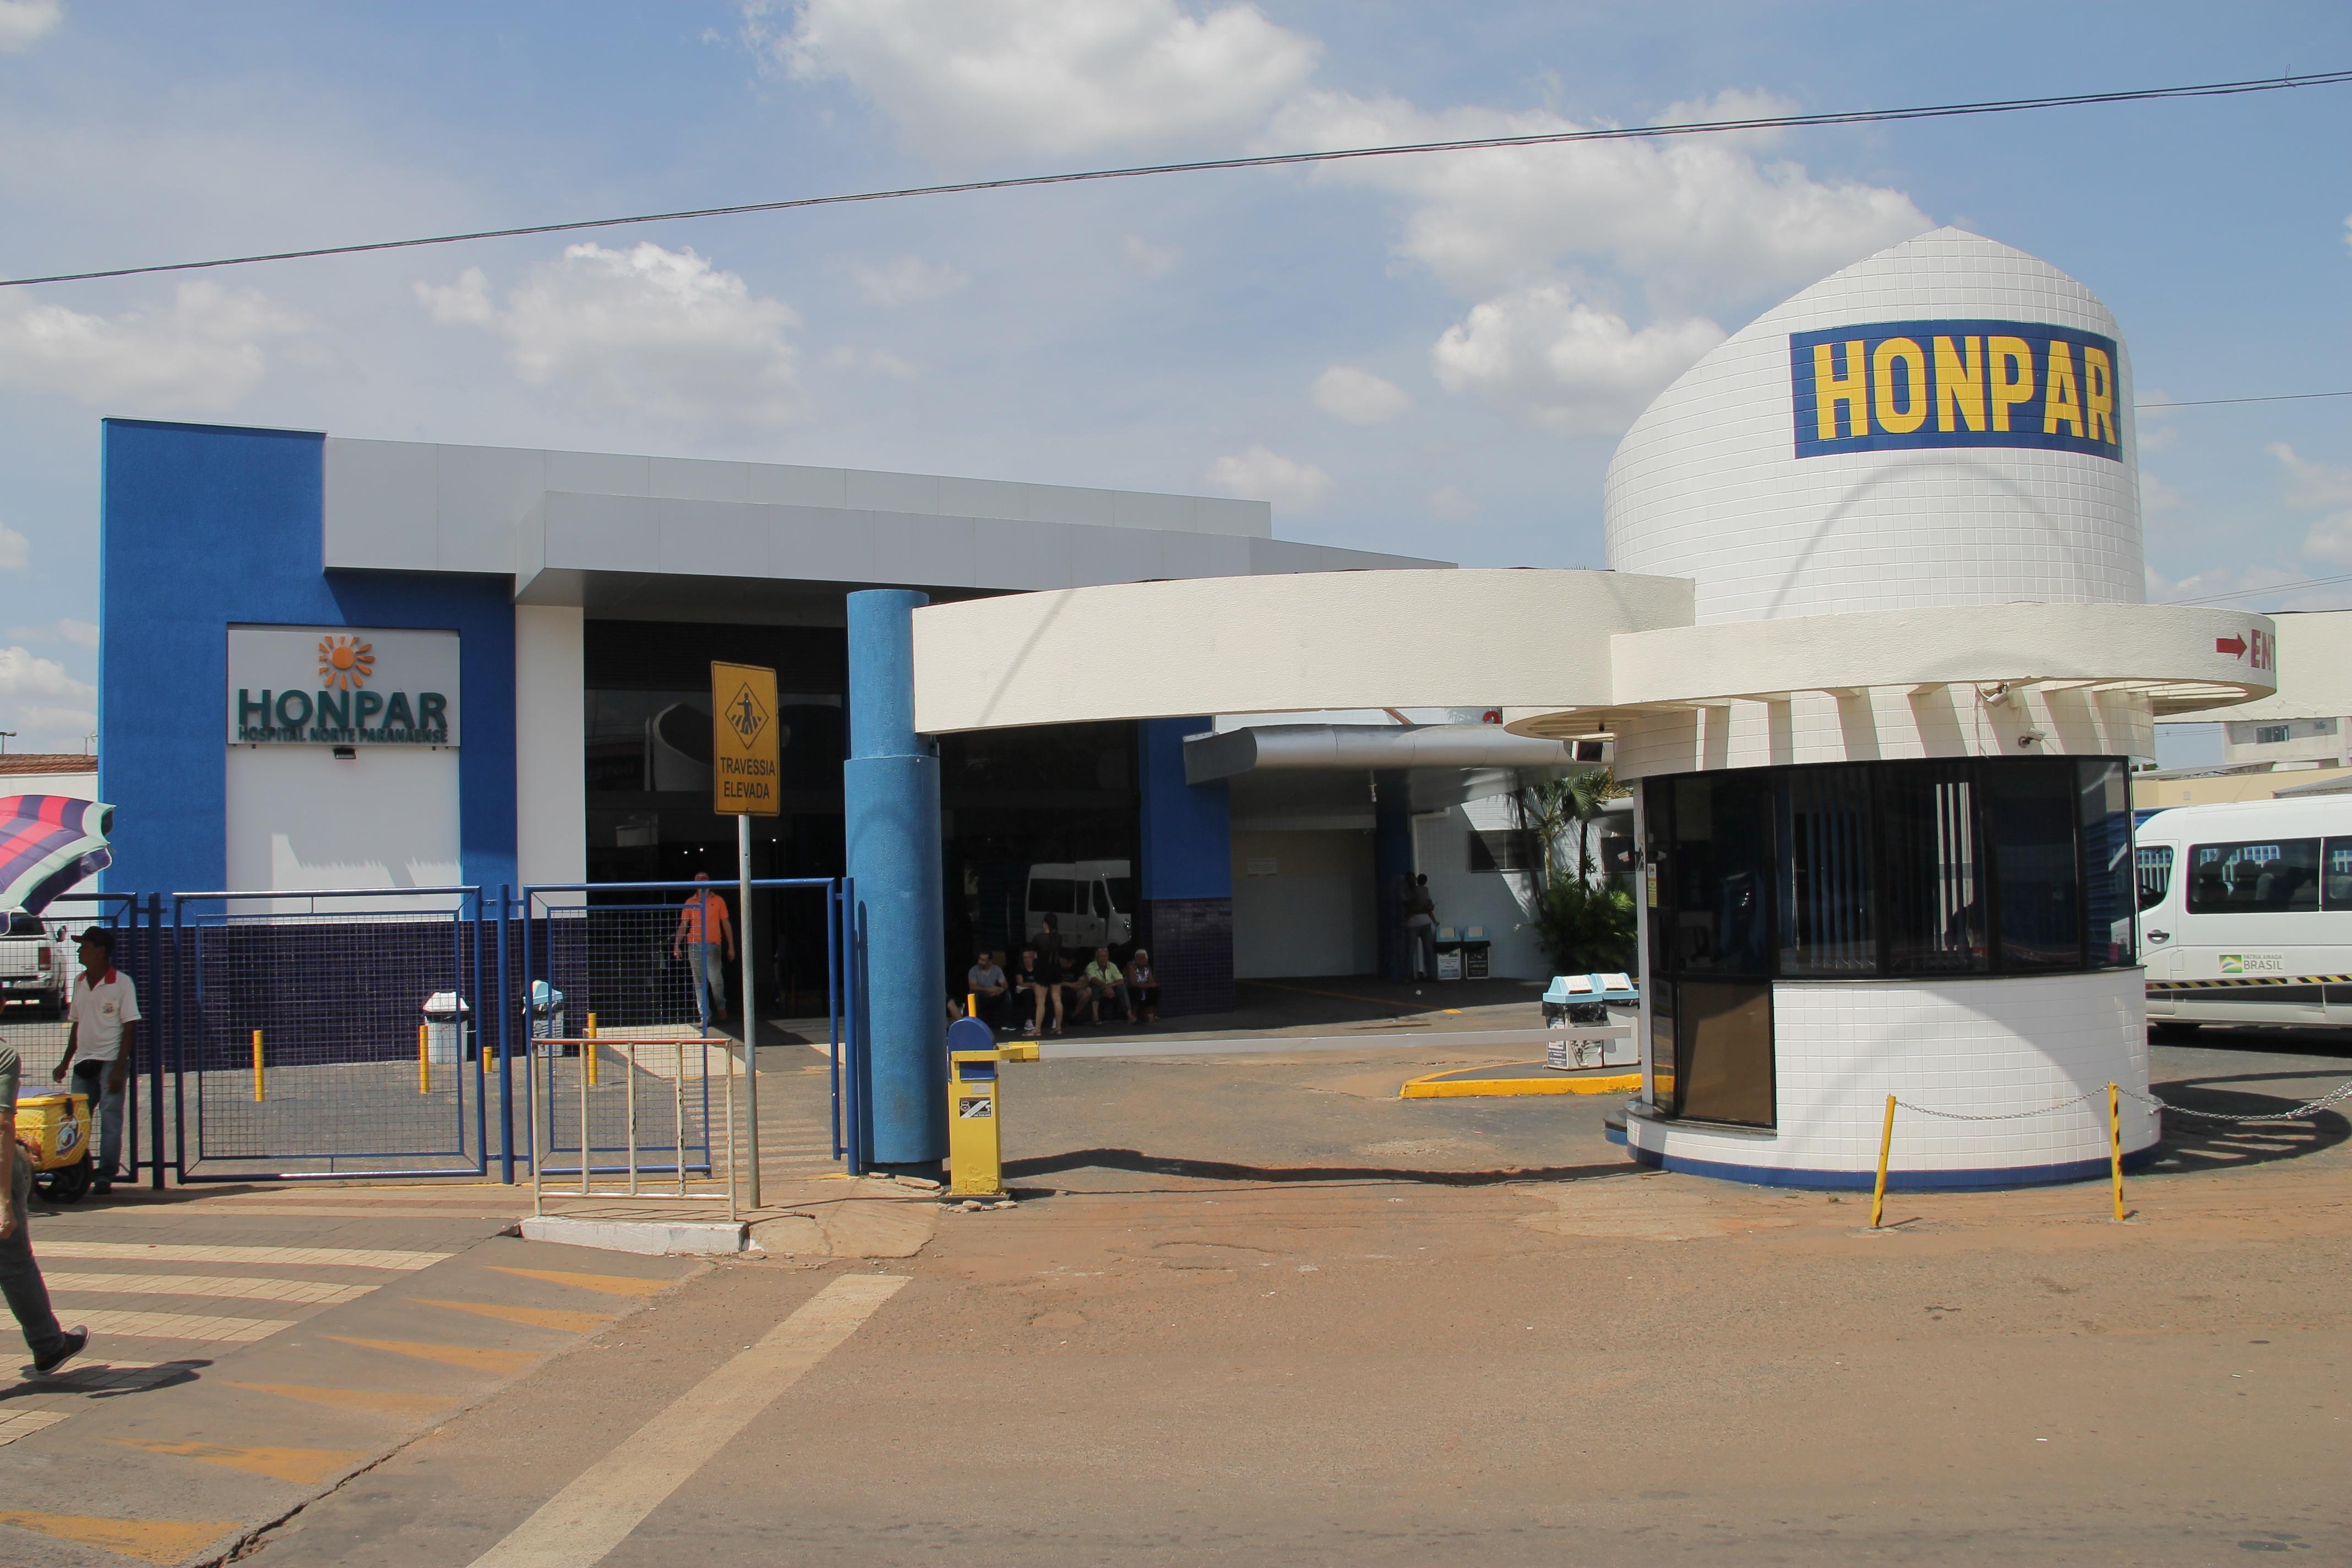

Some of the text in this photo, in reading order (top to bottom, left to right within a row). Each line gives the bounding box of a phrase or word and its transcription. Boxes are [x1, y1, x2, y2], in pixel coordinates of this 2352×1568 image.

[1812, 335, 2116, 445] HONPAR
[238, 688, 448, 728] HONPAR
[239, 726, 448, 743] HOSPITAL NORTE PARANAENSE
[720, 756, 776, 776] TRAVESSIA
[723, 781, 770, 799] ELEVADA
[2244, 960, 2283, 970] BRASIL
